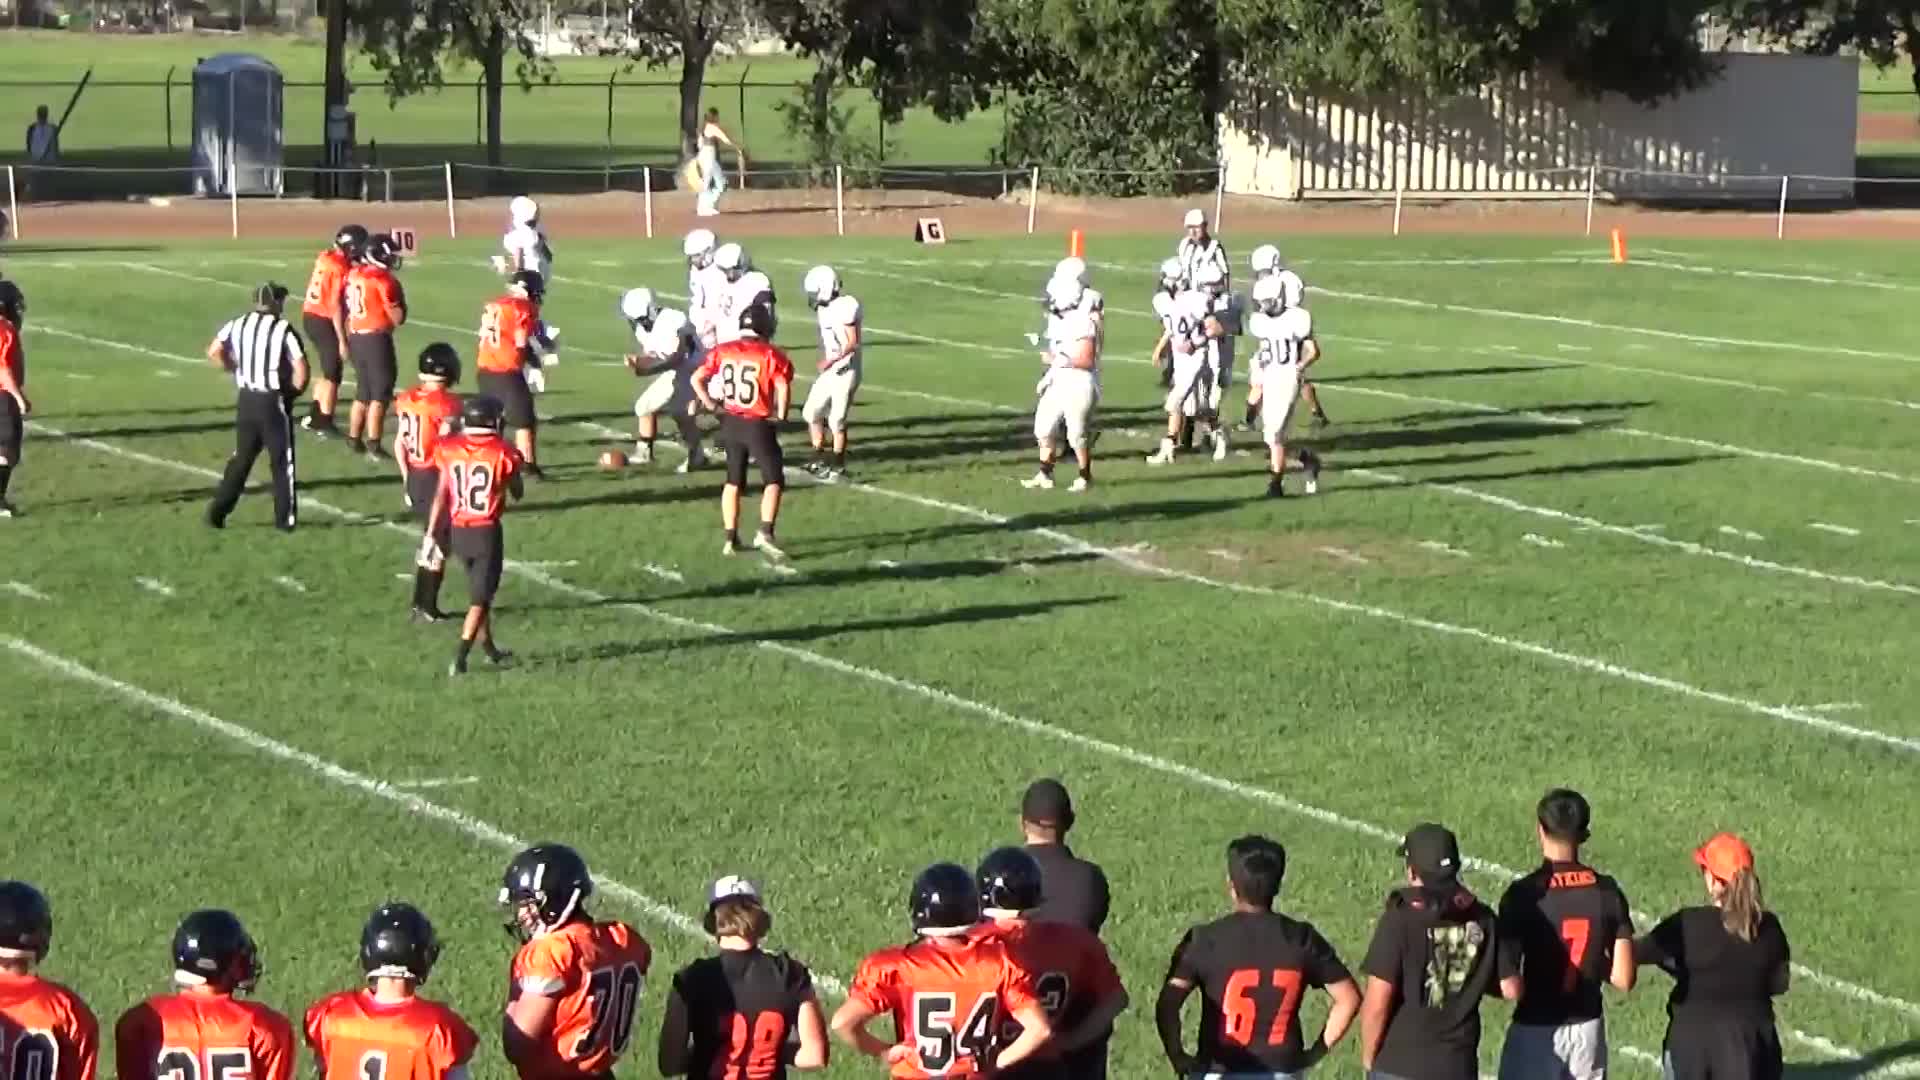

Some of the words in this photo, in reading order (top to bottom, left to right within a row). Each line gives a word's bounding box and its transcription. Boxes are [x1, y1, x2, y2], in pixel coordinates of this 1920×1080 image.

[927, 222, 941, 240] G
[721, 360, 760, 407] 85
[451, 460, 492, 514] 12
[1561, 918, 1590, 992] 7
[913, 991, 1000, 1076] 54
[1222, 968, 1302, 1047] 67
